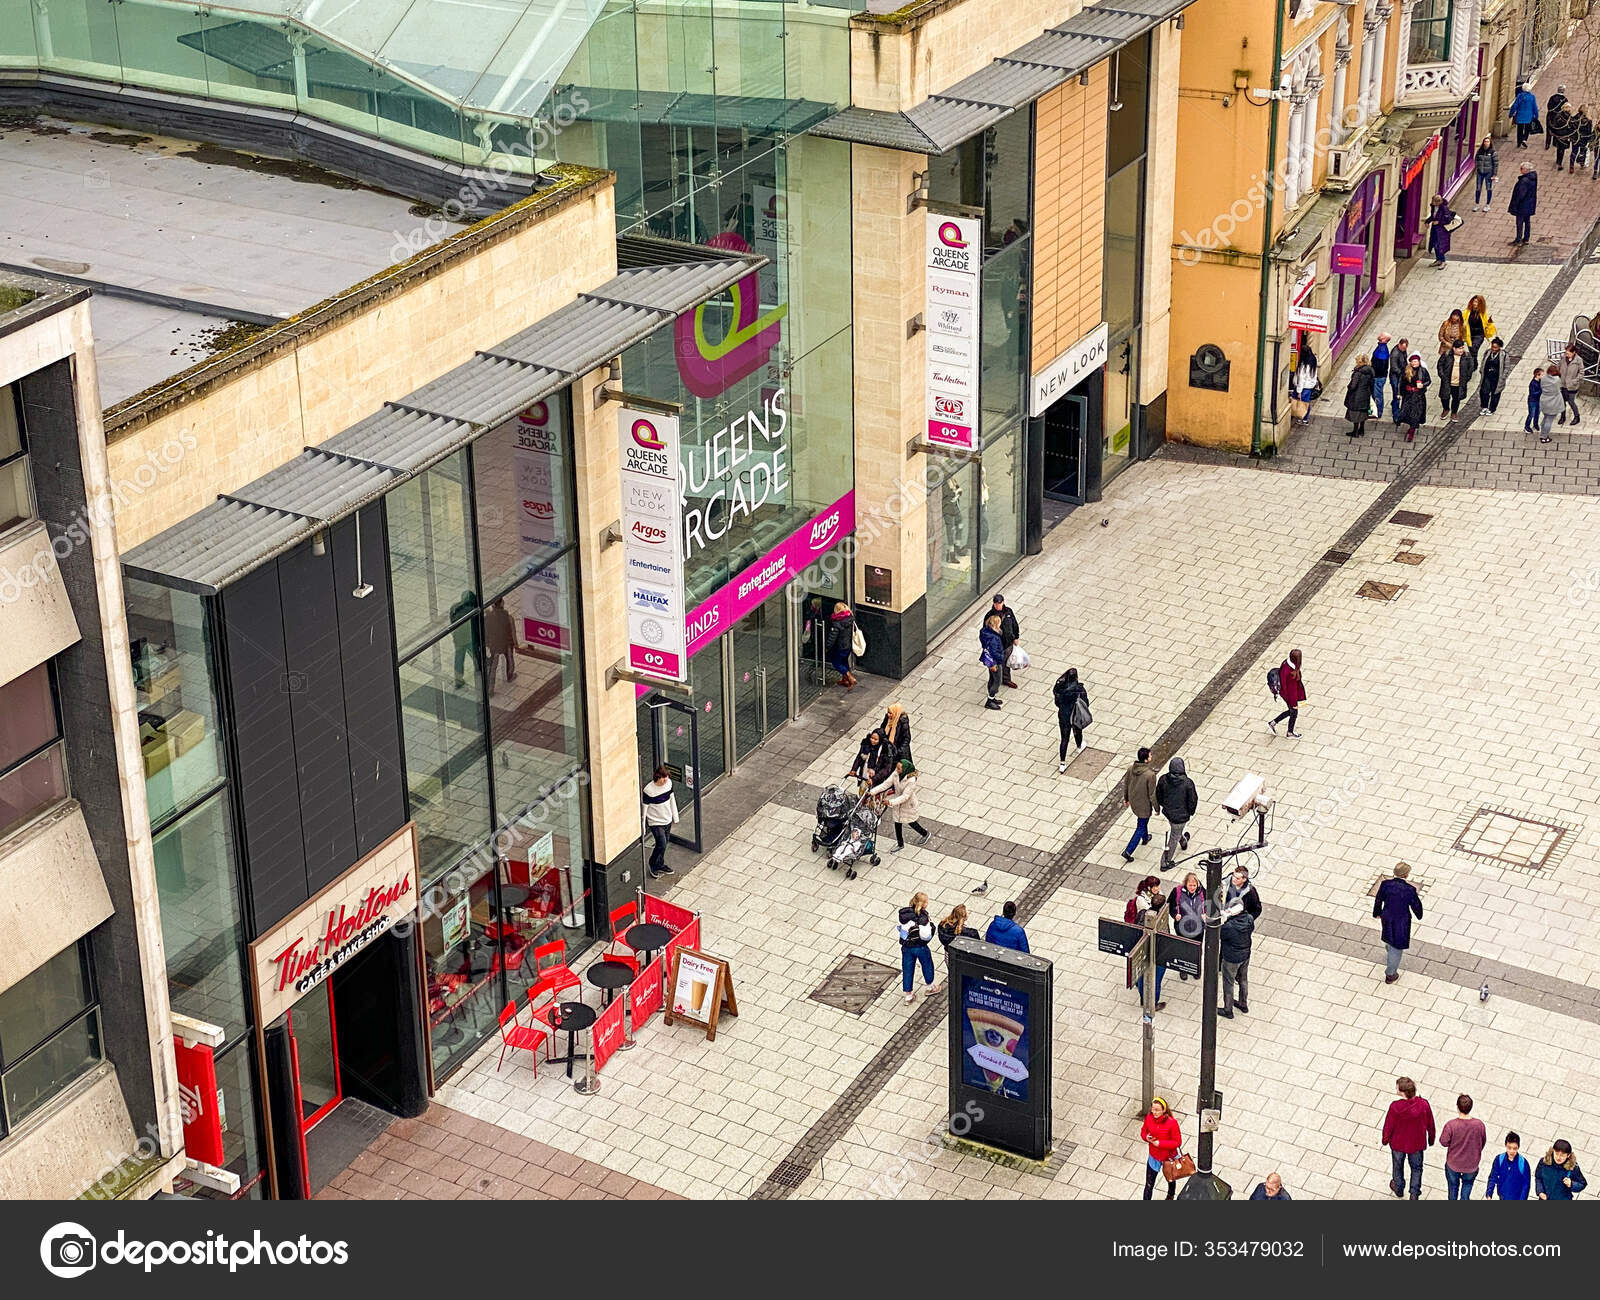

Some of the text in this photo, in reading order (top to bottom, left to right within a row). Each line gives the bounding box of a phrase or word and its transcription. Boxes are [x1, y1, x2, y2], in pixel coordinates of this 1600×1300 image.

[932, 248, 969, 261] QUEENS
[932, 257, 969, 271] ARCADE
[932, 285, 970, 298] Ryman
[1040, 339, 1105, 401] NEW LOOK
[627, 447, 668, 465] QUEENS
[627, 459, 668, 476] ARCADE
[632, 487, 662, 501] NEW
[630, 497, 666, 511] LOOK
[680, 444, 789, 565] RCADE
[632, 521, 667, 539] Argos
[810, 511, 840, 544] Argos
[741, 554, 787, 597] Entertainer
[633, 591, 669, 606] HALIFAX
[329, 958, 336, 972] &
[337, 938, 364, 963] BAKE
[365, 916, 391, 943] SHOP
[273, 936, 319, 991] Tim
[682, 957, 699, 970] Dairy
